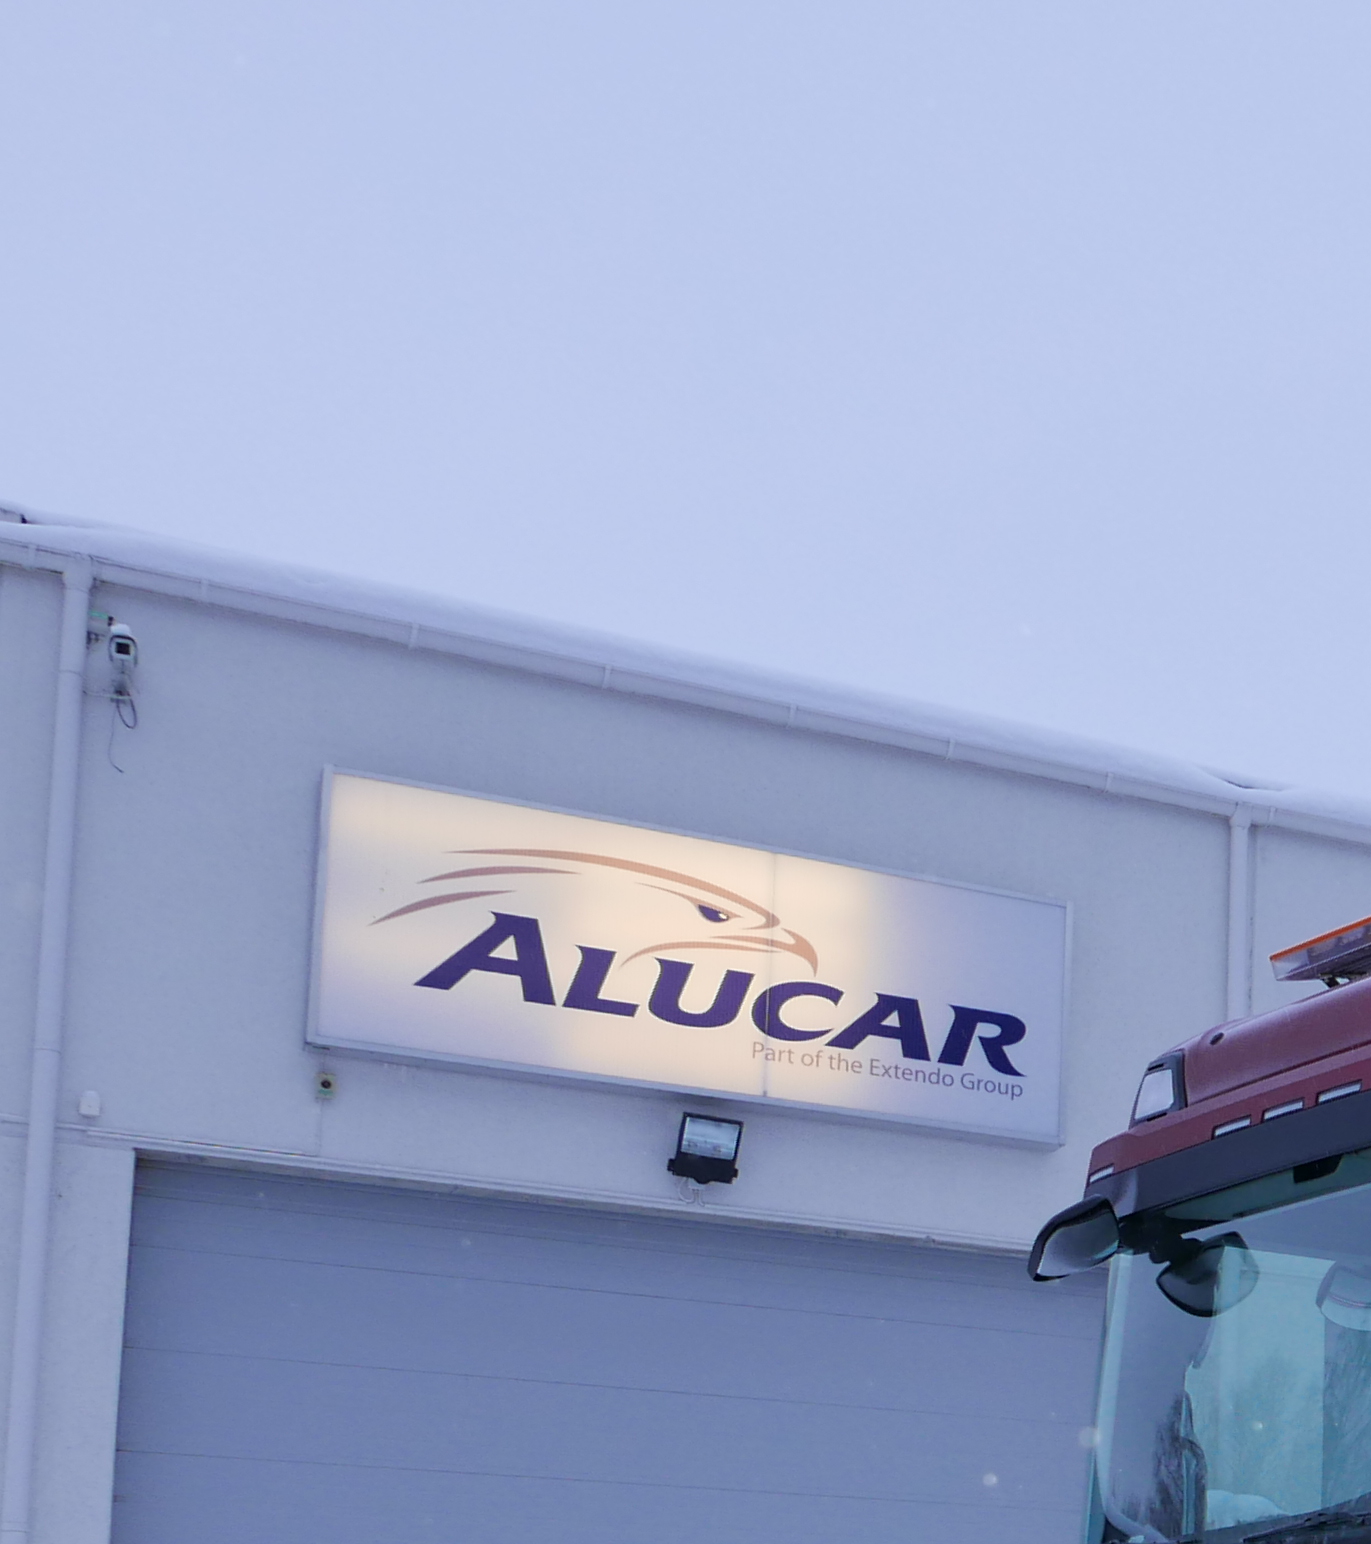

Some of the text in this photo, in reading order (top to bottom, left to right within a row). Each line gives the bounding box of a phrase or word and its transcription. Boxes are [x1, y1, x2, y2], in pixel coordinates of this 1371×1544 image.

[413, 910, 1028, 1078] ALUCAR
[752, 1041, 1024, 1101] Part of the Extendo Group
